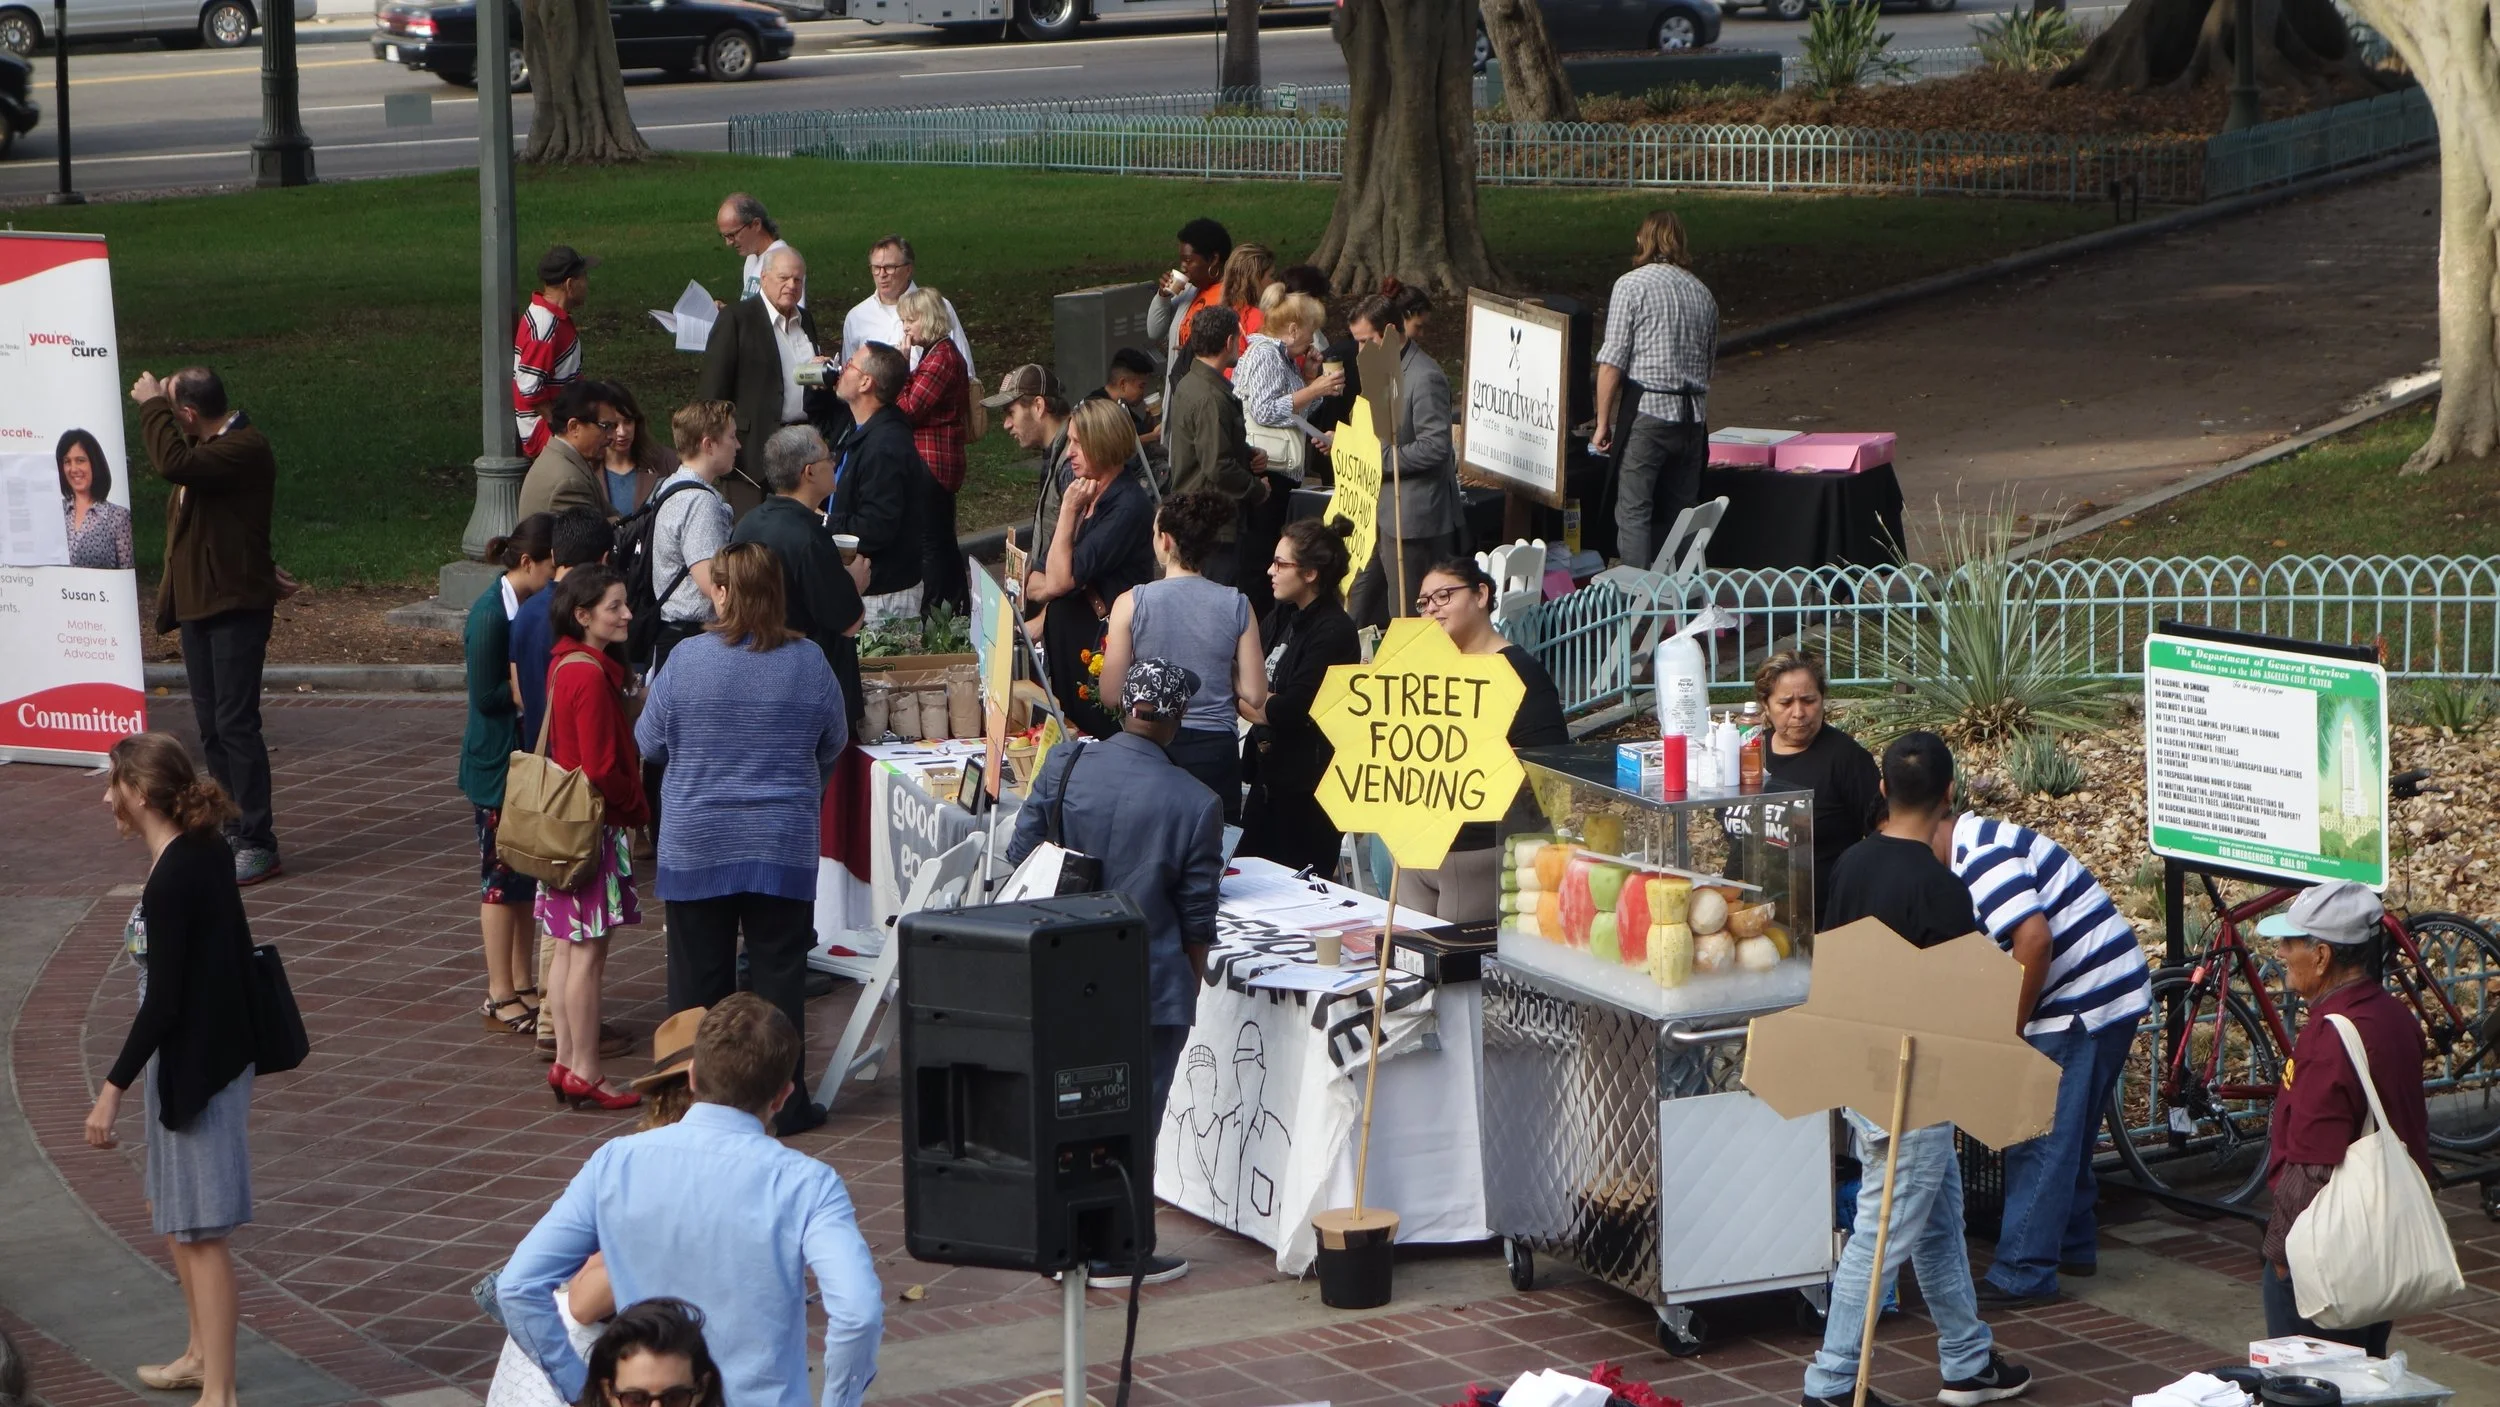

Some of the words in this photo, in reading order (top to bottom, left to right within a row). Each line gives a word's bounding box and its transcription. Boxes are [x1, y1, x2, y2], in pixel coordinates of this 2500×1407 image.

[71, 338, 86, 346] the
[71, 346, 107, 358] cure
[1472, 378, 1555, 431] groundwork
[1483, 417, 1500, 431] coffee
[1505, 424, 1514, 437] tea
[1519, 430, 1548, 449] community
[1470, 440, 1489, 457] LOCALLY
[1490, 447, 1512, 465] ROASTED
[1512, 456, 1534, 473] ORGANIC
[1535, 463, 1555, 480] COFFEE
[1340, 484, 1359, 518] FOOD
[1357, 496, 1372, 529] AND
[61, 588, 96, 602] Susan
[99, 591, 110, 603] S.
[67, 619, 106, 633] Mother,
[57, 632, 108, 648] Caregiver
[111, 637, 119, 647] &
[63, 648, 116, 662] Advocate
[2175, 645, 2193, 657] The
[2196, 649, 2250, 666] Department
[2254, 658, 2264, 667] of
[2267, 659, 2306, 674] General
[2308, 664, 2351, 680] Services
[2190, 659, 2217, 672] Welcomes
[2218, 665, 2229, 674] you
[2230, 666, 2237, 674] to
[2238, 667, 2248, 676] the
[2249, 668, 2262, 679] LOS
[2263, 670, 2289, 682] ANGELES
[2309, 677, 2333, 688] CENTER
[1348, 672, 1491, 719] STREET
[2190, 683, 2210, 692] SMOKING
[18, 702, 143, 735] Committed
[2168, 702, 2180, 711] MUST
[2181, 704, 2187, 712] BE
[2194, 706, 2207, 715] LEASH
[1370, 721, 1468, 763] FOOD
[2156, 736, 2162, 744] NO
[2164, 737, 2187, 748] BLOCKING
[2187, 729, 2203, 739] PUBLIC
[2204, 732, 2226, 742] PROPERTY
[2259, 728, 2280, 739] COOKING
[2164, 758, 2188, 768] FOUNTAINS
[2280, 768, 2302, 779] PLANTERS
[1335, 763, 1486, 812] VENDING
[2164, 770, 2192, 781] TRESPASSING
[2211, 777, 2226, 787] HOURS
[2233, 781, 2252, 791] CLOSURE
[2158, 790, 2172, 798] OTHER
[2173, 792, 2197, 803] MATERIALS
[2221, 800, 2252, 812] LANDSCAPING
[2261, 807, 2277, 817] PUBLIC
[2278, 810, 2301, 820] PROPERTY
[2158, 802, 2164, 810] NO
[2165, 803, 2186, 813] BLOCKING
[2237, 815, 2260, 826] BUILDINGS
[893, 785, 946, 852] good
[2158, 814, 2164, 822] NO
[2234, 827, 2267, 839] AMPLIFICATION
[2219, 846, 2231, 857] FOR
[2280, 856, 2296, 869] CALL
[2296, 859, 2307, 870] 911
